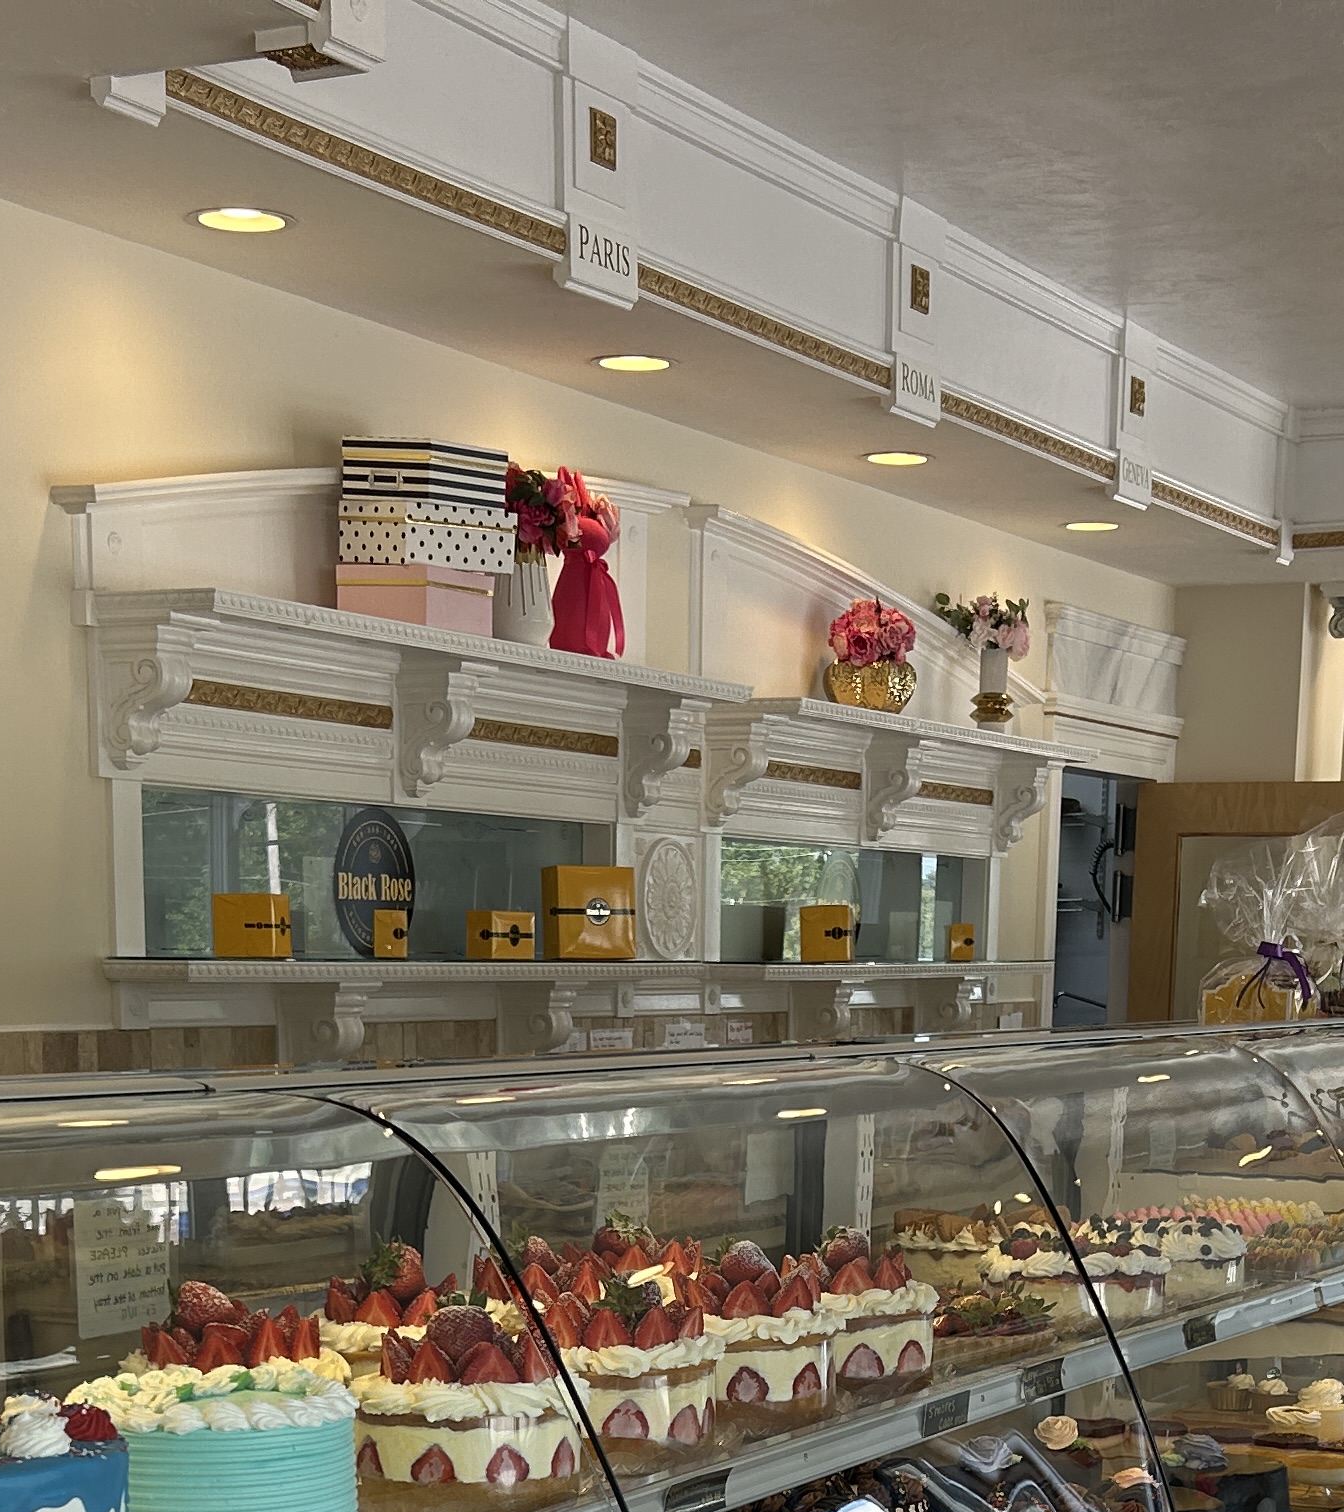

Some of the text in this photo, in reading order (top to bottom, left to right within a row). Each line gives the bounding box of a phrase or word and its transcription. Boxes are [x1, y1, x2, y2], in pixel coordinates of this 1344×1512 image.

[578, 223, 631, 277] PARIS
[902, 362, 935, 403] ROMA
[1122, 456, 1150, 490] GENEVA
[337, 872, 412, 901] Black Rose
